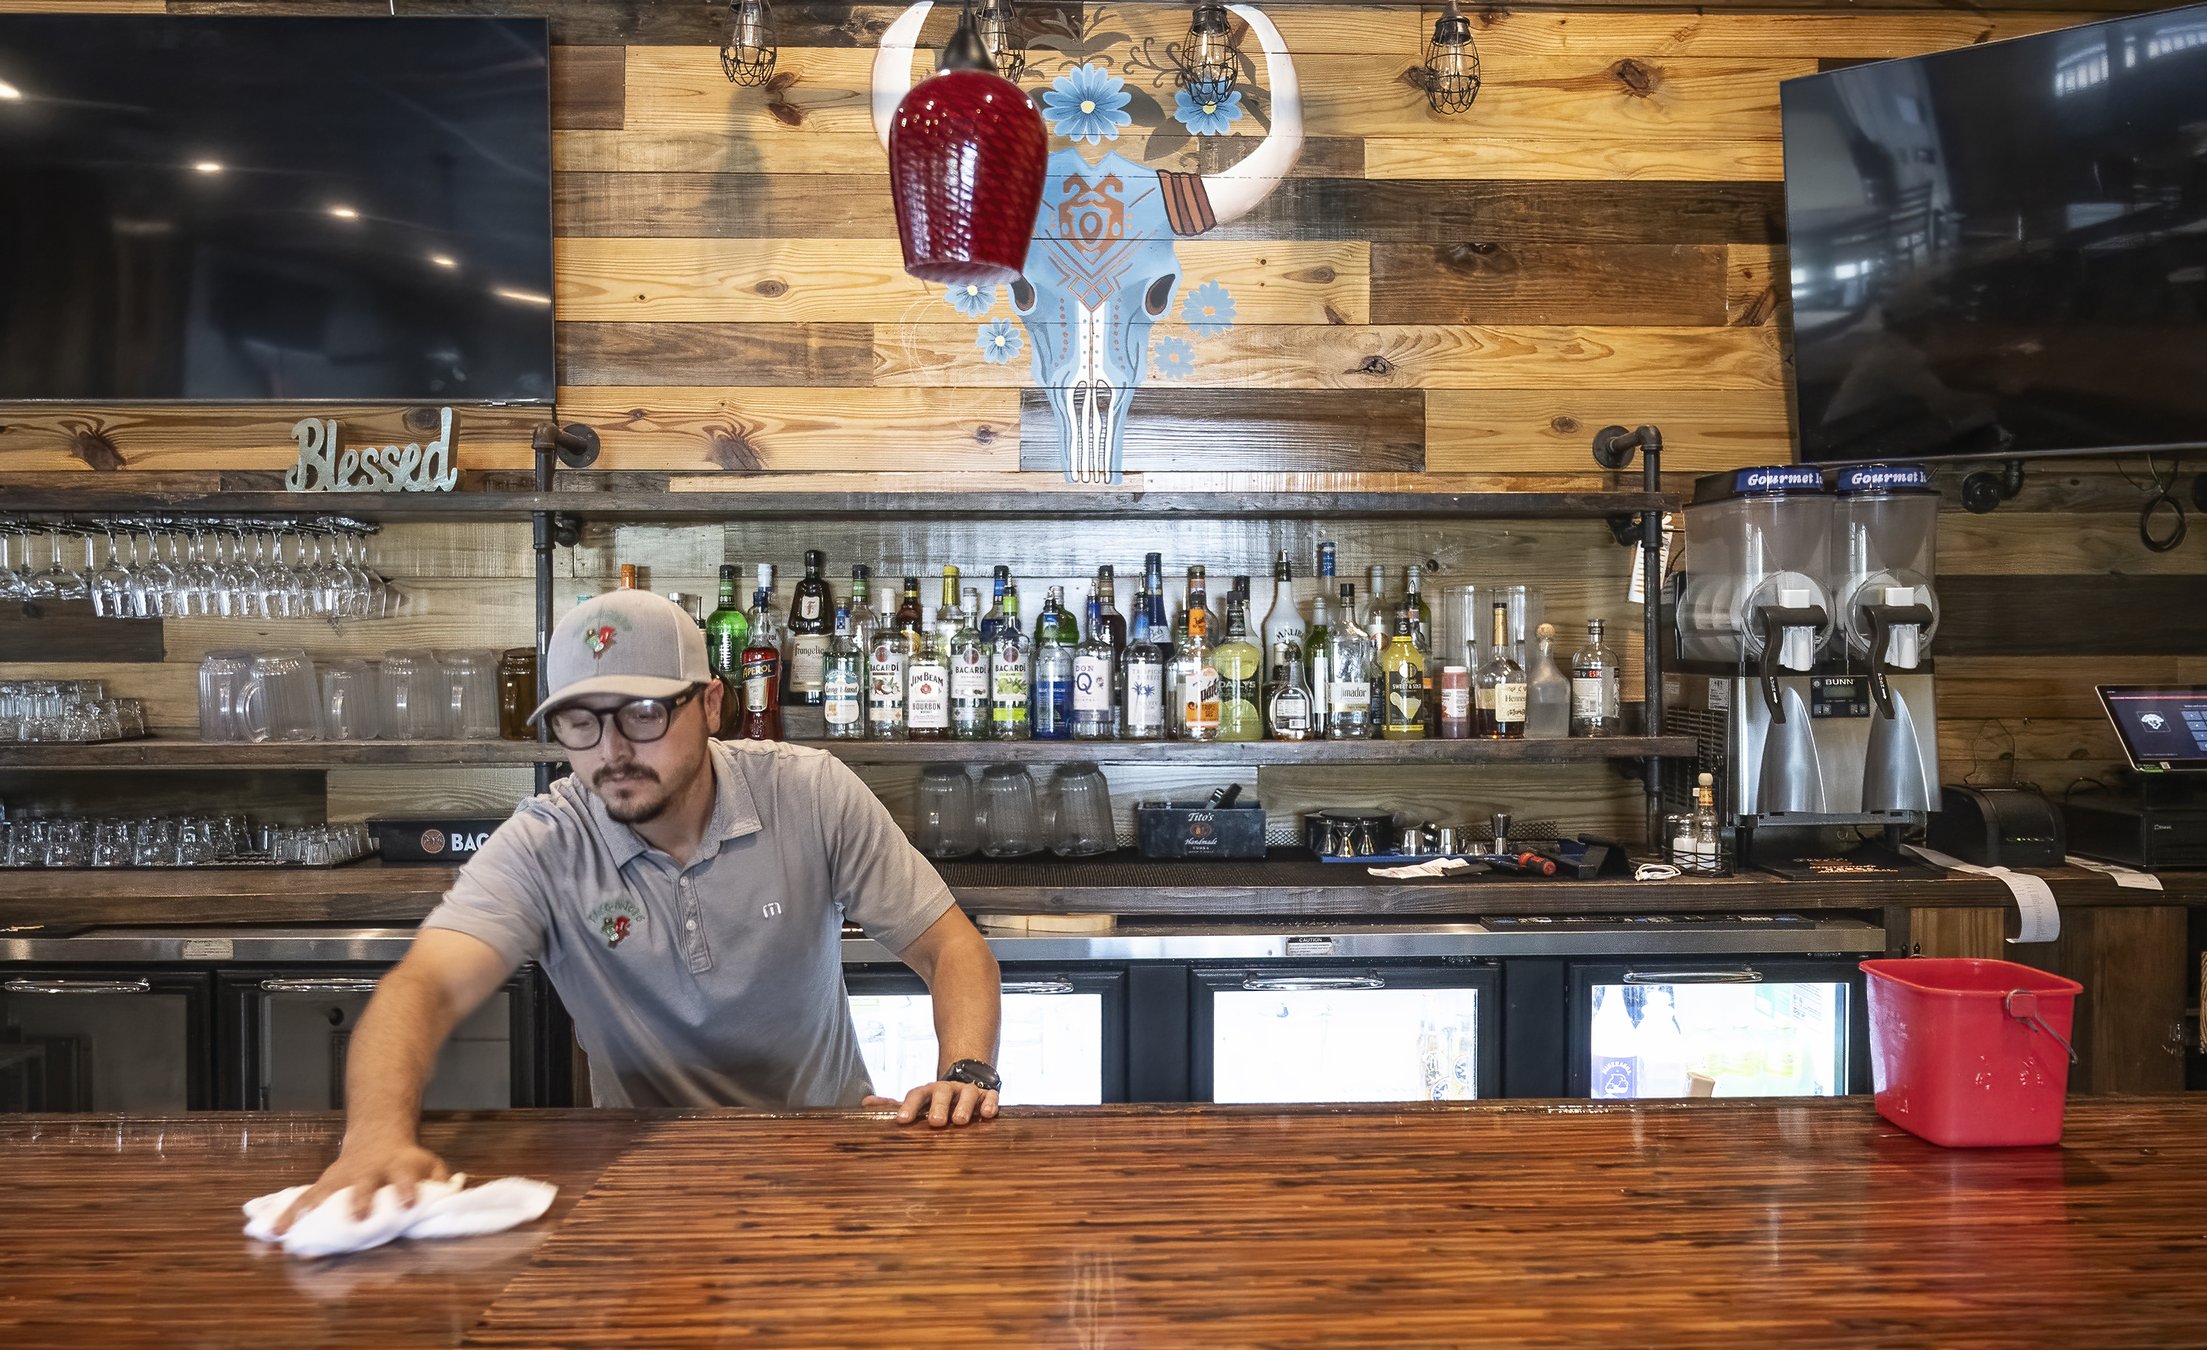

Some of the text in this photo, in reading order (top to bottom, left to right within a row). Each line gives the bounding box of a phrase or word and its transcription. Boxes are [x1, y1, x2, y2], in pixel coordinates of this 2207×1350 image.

[285, 406, 458, 492] Blessed
[1748, 473, 1813, 486] Gourmet
[1852, 472, 1917, 485] Gourmet
[743, 664, 772, 677] APEROL
[911, 672, 944, 687] JIM BEAM
[1076, 672, 1092, 695] Q
[912, 702, 941, 710] BOURBON
[1188, 812, 1215, 822] Tito's
